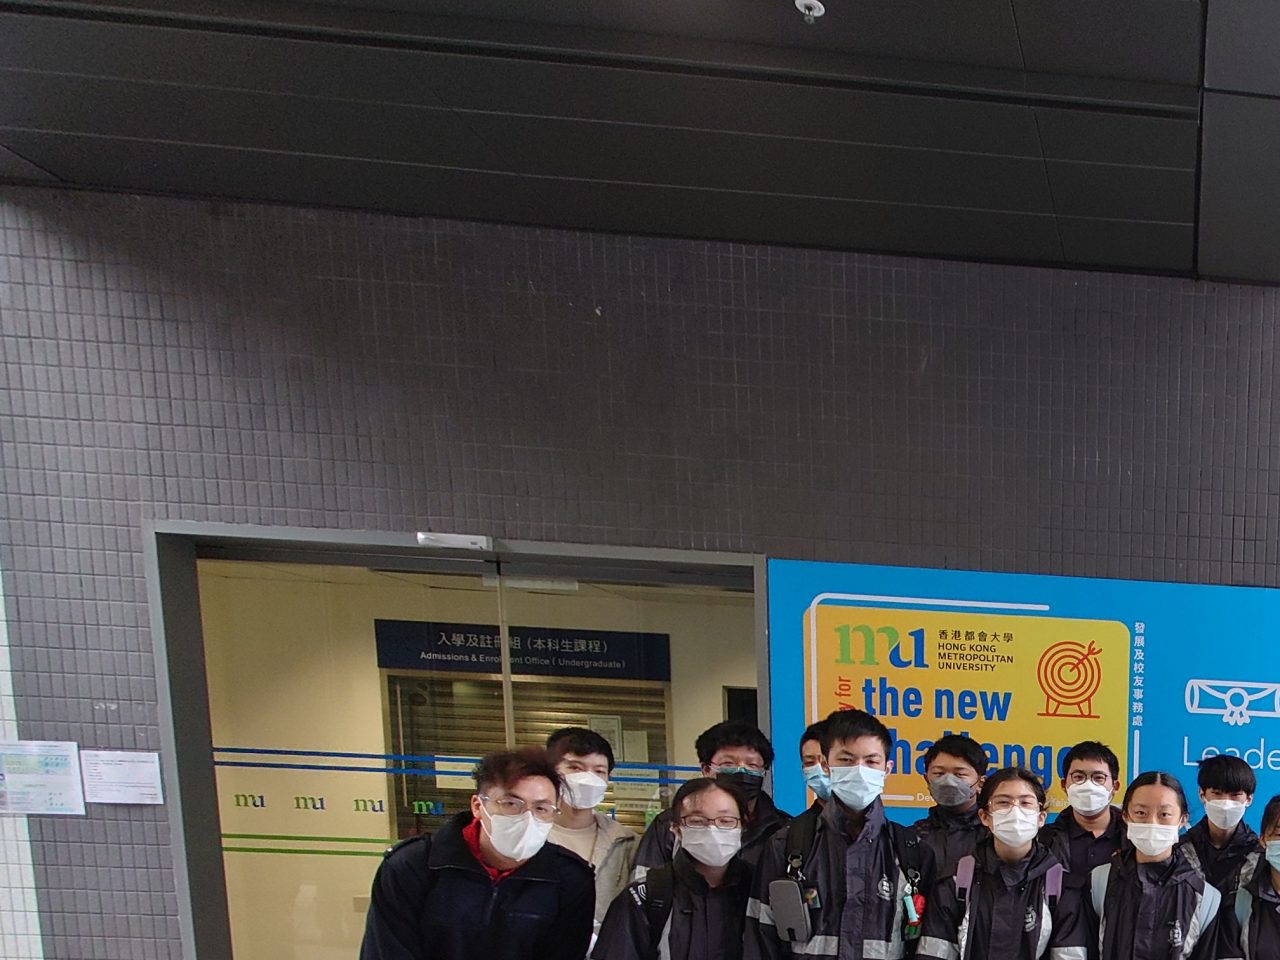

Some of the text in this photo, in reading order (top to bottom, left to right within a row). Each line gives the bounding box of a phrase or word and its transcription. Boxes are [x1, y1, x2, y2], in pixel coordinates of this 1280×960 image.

[938, 629, 1014, 644] 香港都會大學
[938, 642, 996, 653] HONG KONG
[420, 651, 469, 662] Admissions
[525, 656, 550, 666] Office
[938, 652, 1014, 664] METROPOLITAN
[938, 662, 996, 672] UNIVERSITY
[1132, 622, 1145, 727] 發展及校友事務處
[834, 676, 851, 698] for
[862, 677, 1013, 722] the new
[887, 728, 1074, 791] haeng
